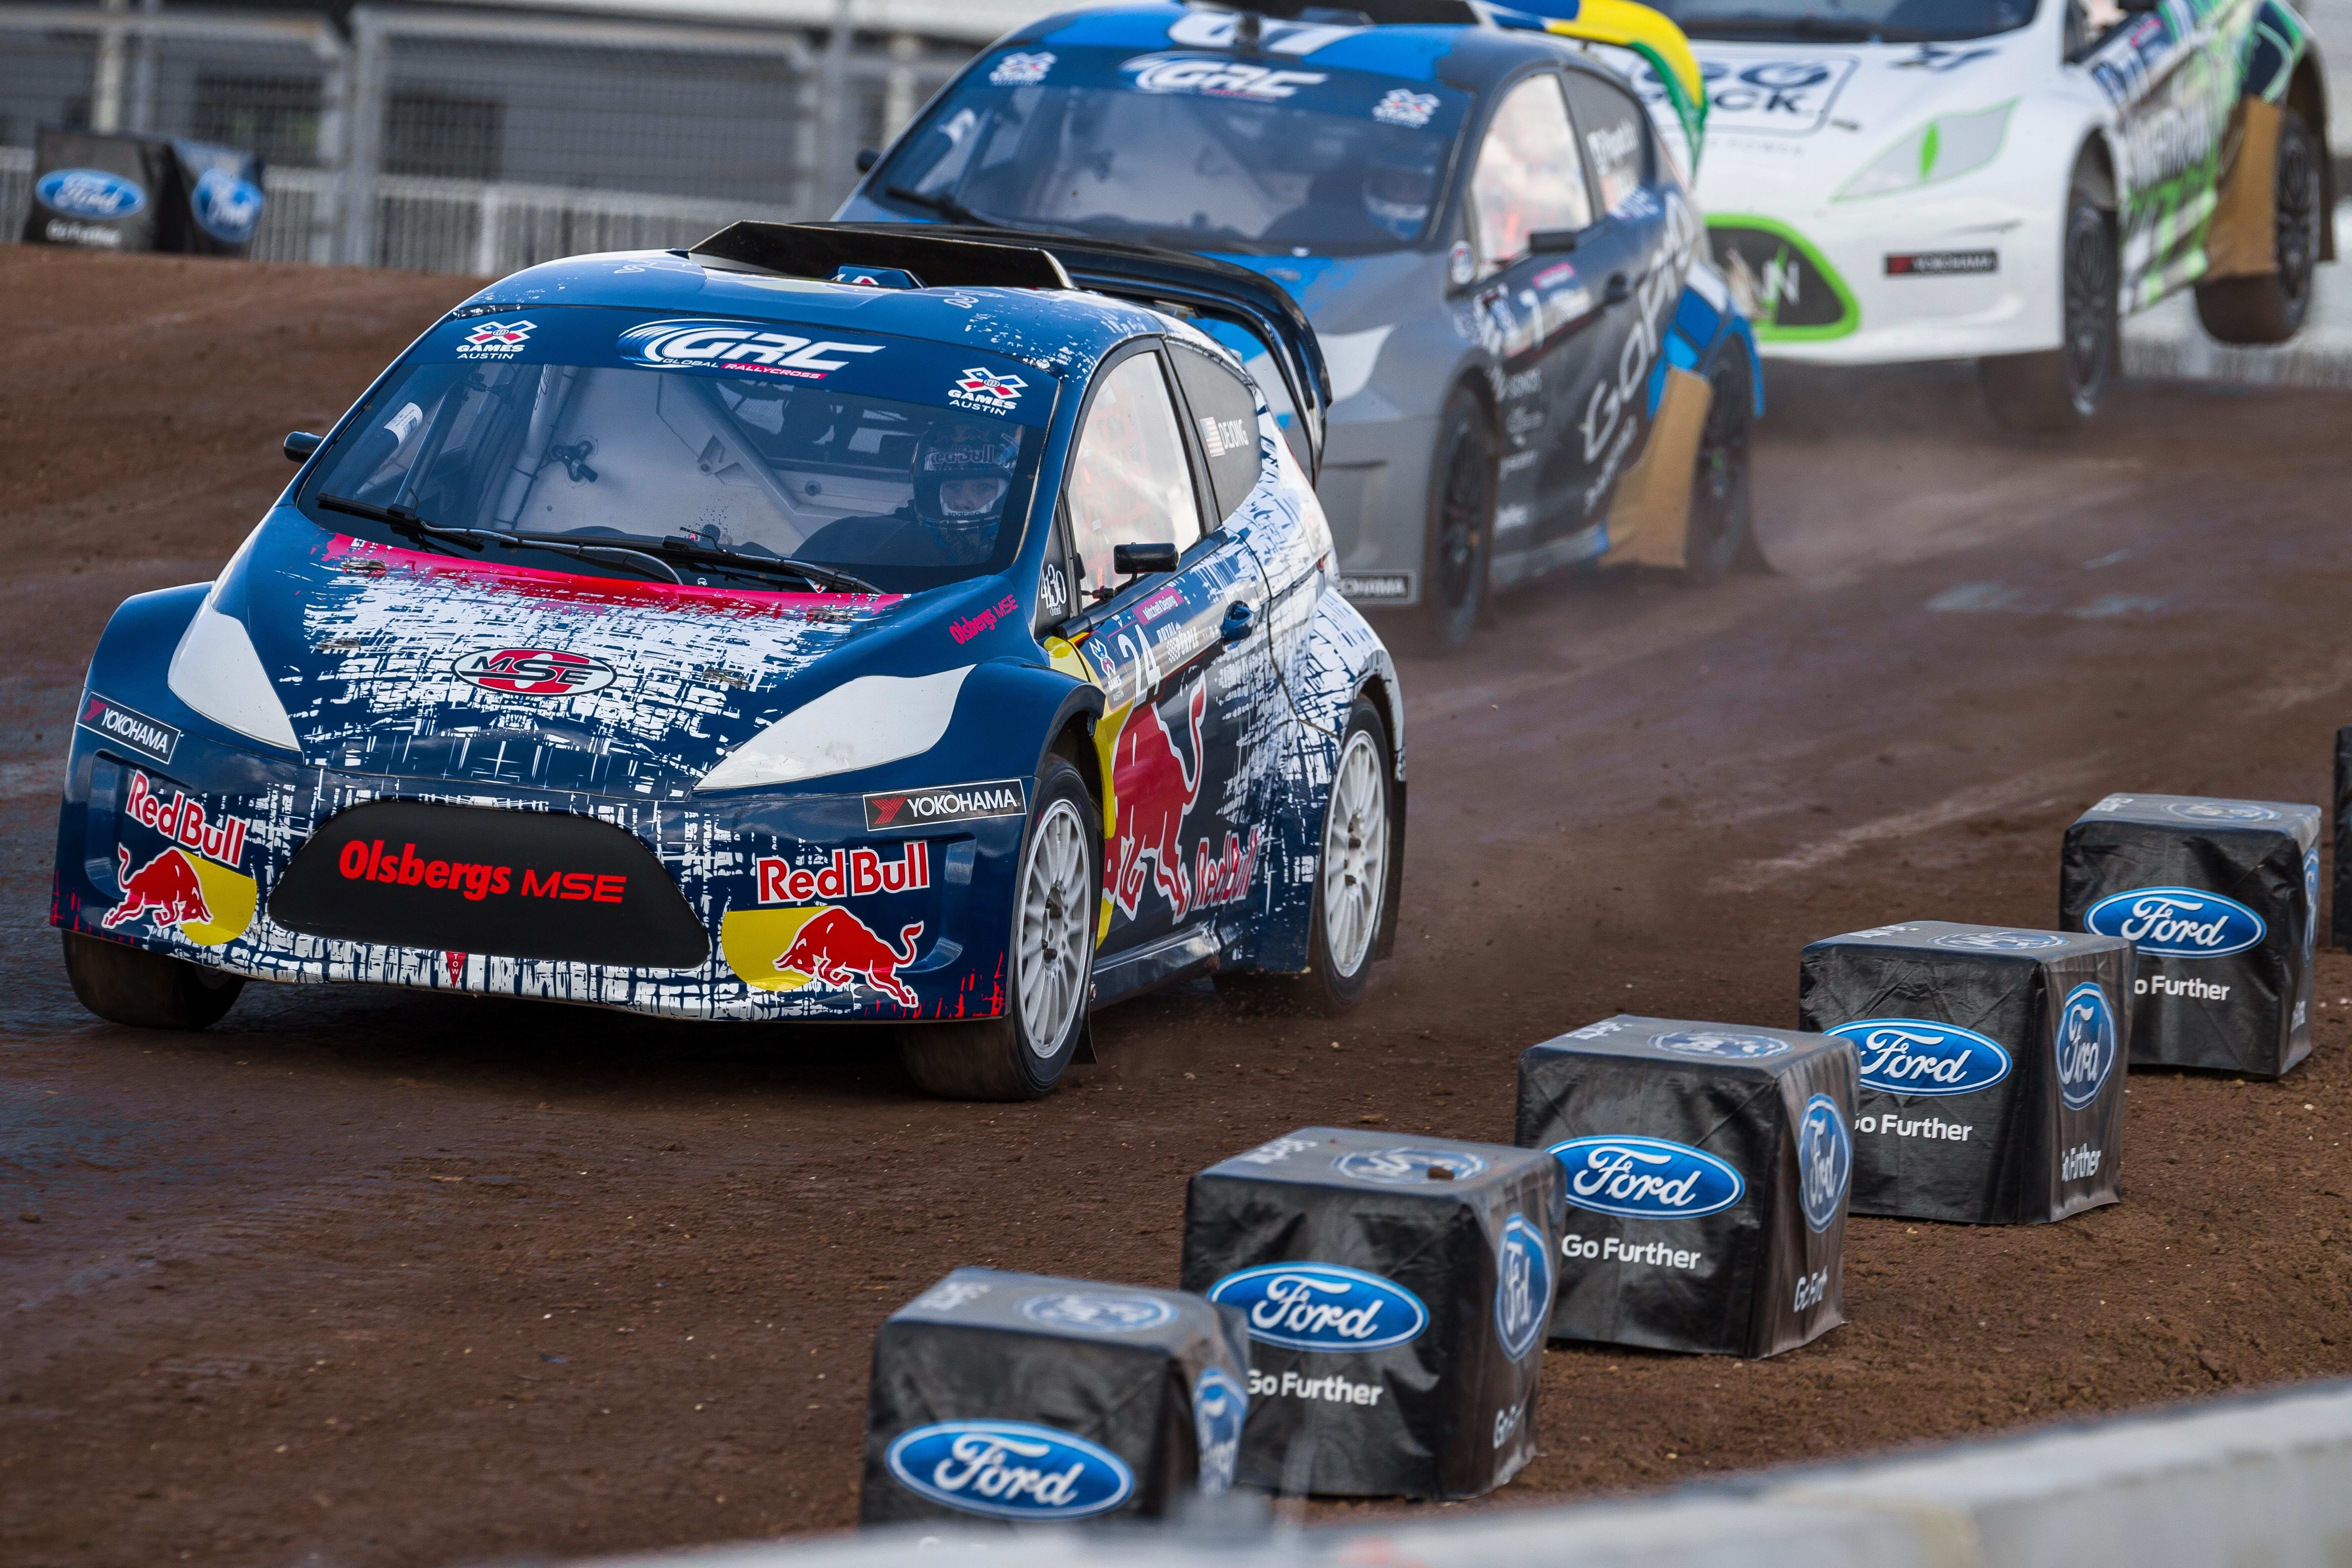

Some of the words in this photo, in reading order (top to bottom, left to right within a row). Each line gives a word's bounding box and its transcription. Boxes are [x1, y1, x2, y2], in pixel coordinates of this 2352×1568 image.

[662, 329, 886, 371] GRC
[663, 357, 719, 368] GLOBAL
[724, 363, 821, 379] RALLYCROSS
[948, 389, 1017, 409] GAMES
[949, 399, 1006, 416] AUSTIN
[1040, 564, 1066, 609] 4130
[1156, 622, 1177, 643] ROYAL
[1175, 626, 1199, 658] PURPLE
[470, 655, 594, 686] MSE
[1108, 675, 1122, 692] GAMES
[1118, 624, 1162, 706] 24
[1113, 689, 1124, 702] AUSTIN
[100, 707, 168, 753] YOKOHAMA
[125, 769, 185, 841] Red
[177, 797, 251, 869] Bull
[907, 789, 1018, 818] YOKOHAMA
[339, 840, 511, 901] Olsbergs
[521, 869, 627, 904] MSE
[756, 848, 848, 905] Red
[849, 840, 930, 897] Bull
[1190, 830, 1232, 912] Red
[1218, 823, 1261, 905] Bull
[2121, 897, 2230, 947] Ford
[2151, 975, 2231, 1001] Further
[1859, 1029, 1974, 1084] Ford
[1881, 1114, 1973, 1142] Further
[1573, 1146, 1702, 1207] Ford
[1562, 1234, 1600, 1259] Go
[1603, 1237, 1701, 1270] Further
[1251, 1274, 1384, 1339] Ford
[1248, 1368, 1279, 1396] Go
[1281, 1371, 1384, 1406] Further
[933, 1432, 1085, 1507] Ford
